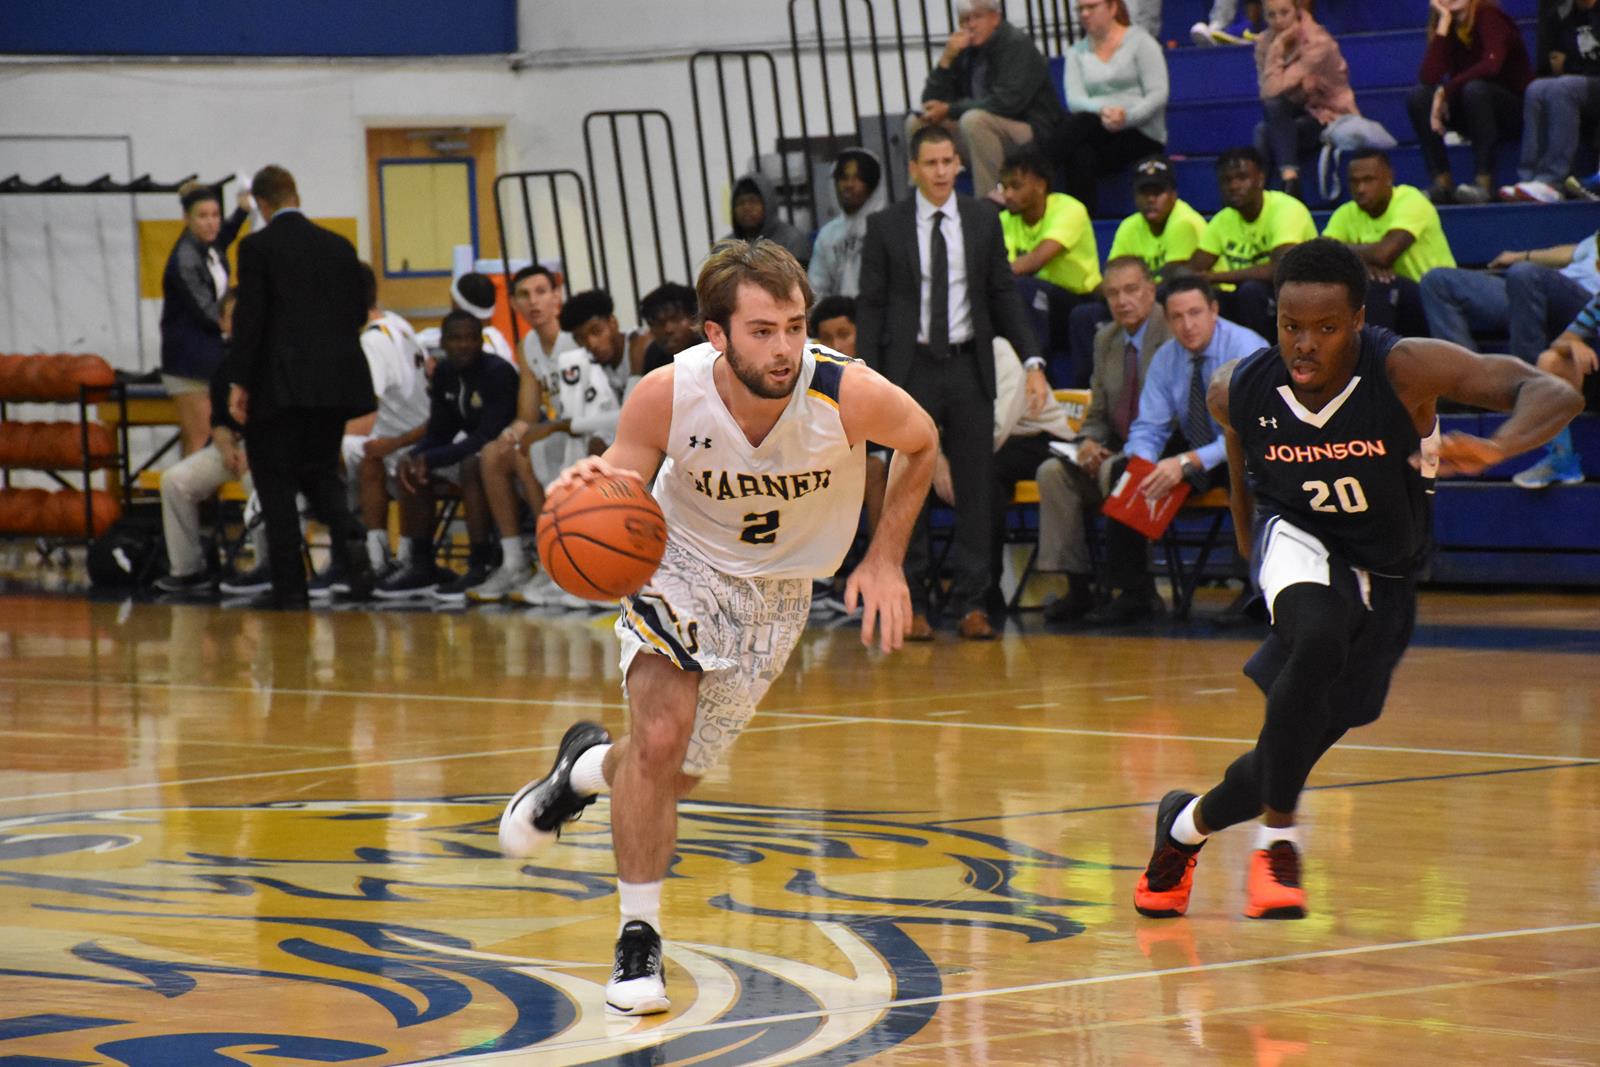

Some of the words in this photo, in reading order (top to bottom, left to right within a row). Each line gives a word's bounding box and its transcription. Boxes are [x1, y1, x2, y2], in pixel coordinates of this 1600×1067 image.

[1264, 440, 1387, 462] JOHNSON
[1301, 476, 1369, 513] 20
[739, 510, 780, 545] 2
